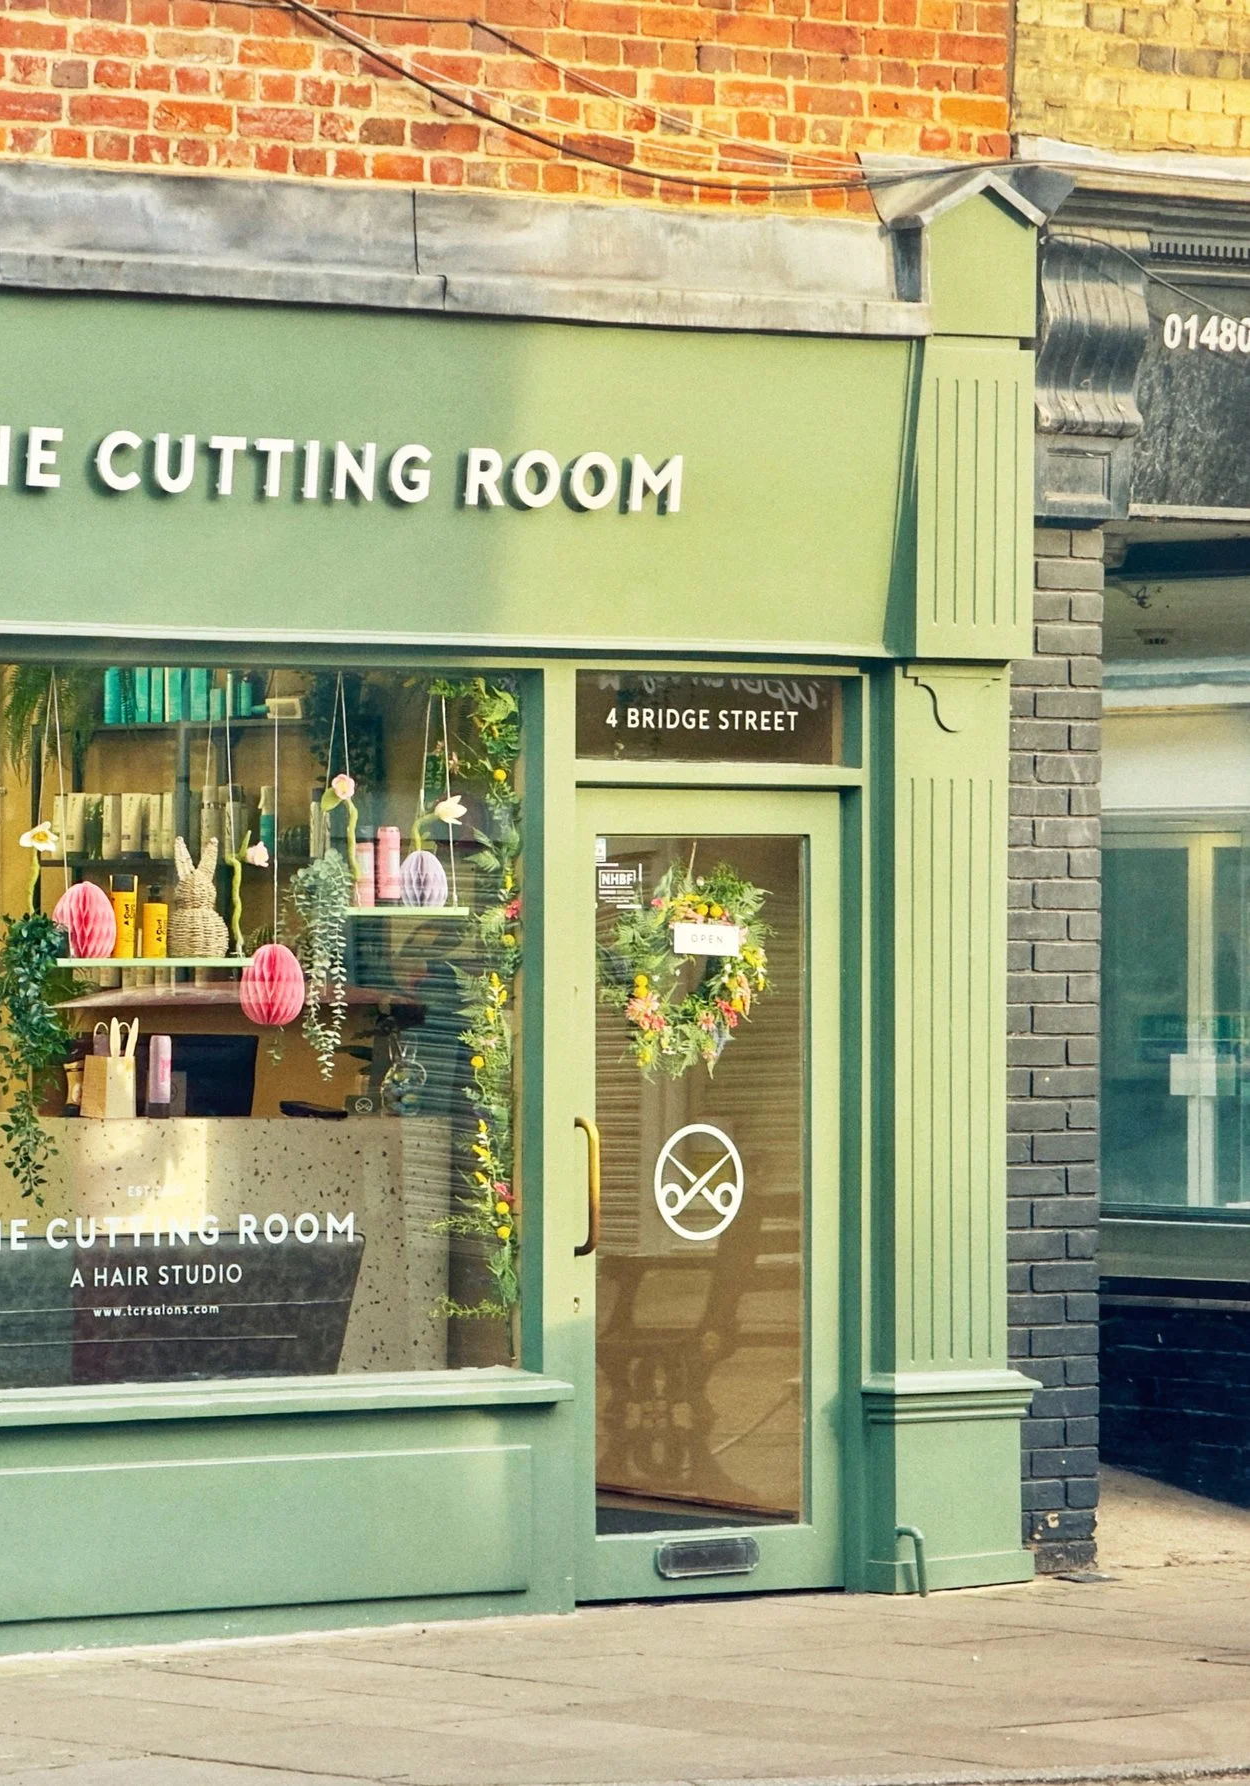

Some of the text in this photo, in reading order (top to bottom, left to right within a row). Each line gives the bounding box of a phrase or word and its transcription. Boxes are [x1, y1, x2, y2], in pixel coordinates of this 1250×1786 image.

[95, 429, 432, 504] CUTTING
[463, 447, 684, 513] ROOM
[605, 707, 799, 731] 4 BRIDGE STREET
[601, 872, 634, 885] NHBF
[690, 933, 724, 944] OPEN
[46, 1215, 220, 1249] CUTTING
[239, 1212, 354, 1244] ROOM
[70, 1263, 243, 1288] A HAIR STUDIO
[93, 1304, 219, 1317] www.tcrsalons.com
